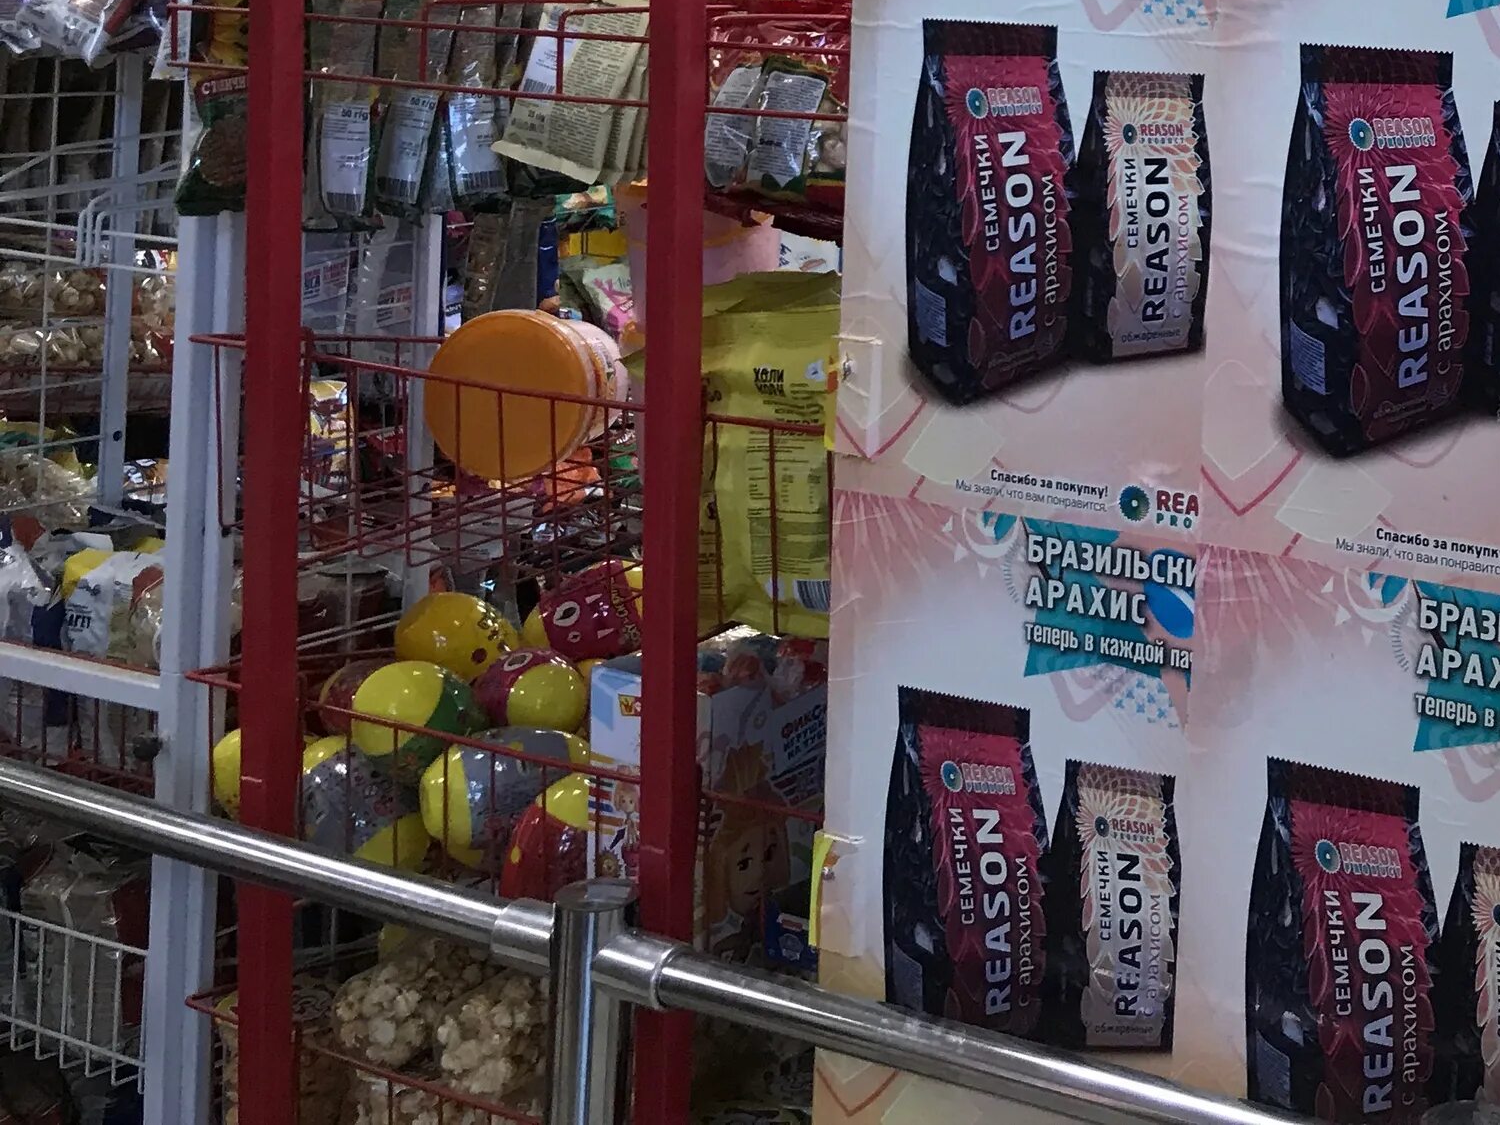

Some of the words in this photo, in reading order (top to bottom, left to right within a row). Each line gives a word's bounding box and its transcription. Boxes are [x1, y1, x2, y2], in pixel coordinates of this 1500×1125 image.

[987, 87, 1040, 106] REASON
[1139, 123, 1185, 137] REASON
[1373, 118, 1433, 137] REASON
[974, 134, 999, 252] СЕМЕЧКИ
[1127, 158, 1138, 249] СЕМЕЧКИ
[998, 131, 1038, 340] REASON
[1142, 157, 1171, 324] REASON
[1357, 167, 1386, 293] СЕМЕЧКИ
[1384, 164, 1428, 389] REASON
[1435, 211, 1453, 352] арахисом
[753, 367, 785, 383] ХОЛИ
[955, 478, 972, 492] Мы
[1007, 489, 1024, 500] что
[1026, 492, 1045, 504] вам
[990, 468, 1037, 488] Спасибо
[1040, 478, 1053, 489] за
[1055, 481, 1109, 499] покупку!
[1156, 489, 1199, 517] REA
[1156, 514, 1193, 529] PRO
[1335, 537, 1354, 553] Мы
[1394, 548, 1414, 560] что
[1416, 552, 1439, 565] вам
[1376, 527, 1430, 548] Спасибо
[1433, 538, 1448, 550] за
[1025, 577, 1146, 625] АРАХИС
[1025, 623, 1079, 652] теперь
[1084, 634, 1094, 652] в
[1100, 636, 1164, 665] каждой
[1416, 693, 1477, 725] теперь
[1484, 708, 1495, 728] в
[948, 807, 975, 925] СЕМЕЧКИ
[1339, 842, 1401, 868] REASON
[972, 809, 1012, 1016] REASON
[1099, 850, 1109, 942] СЕМЕЧКИ
[1114, 853, 1142, 1017] REASON
[1323, 889, 1351, 1017] СЕМЕЧКИ
[1352, 891, 1394, 1114] REASON
[1400, 945, 1421, 1084] арахисом
